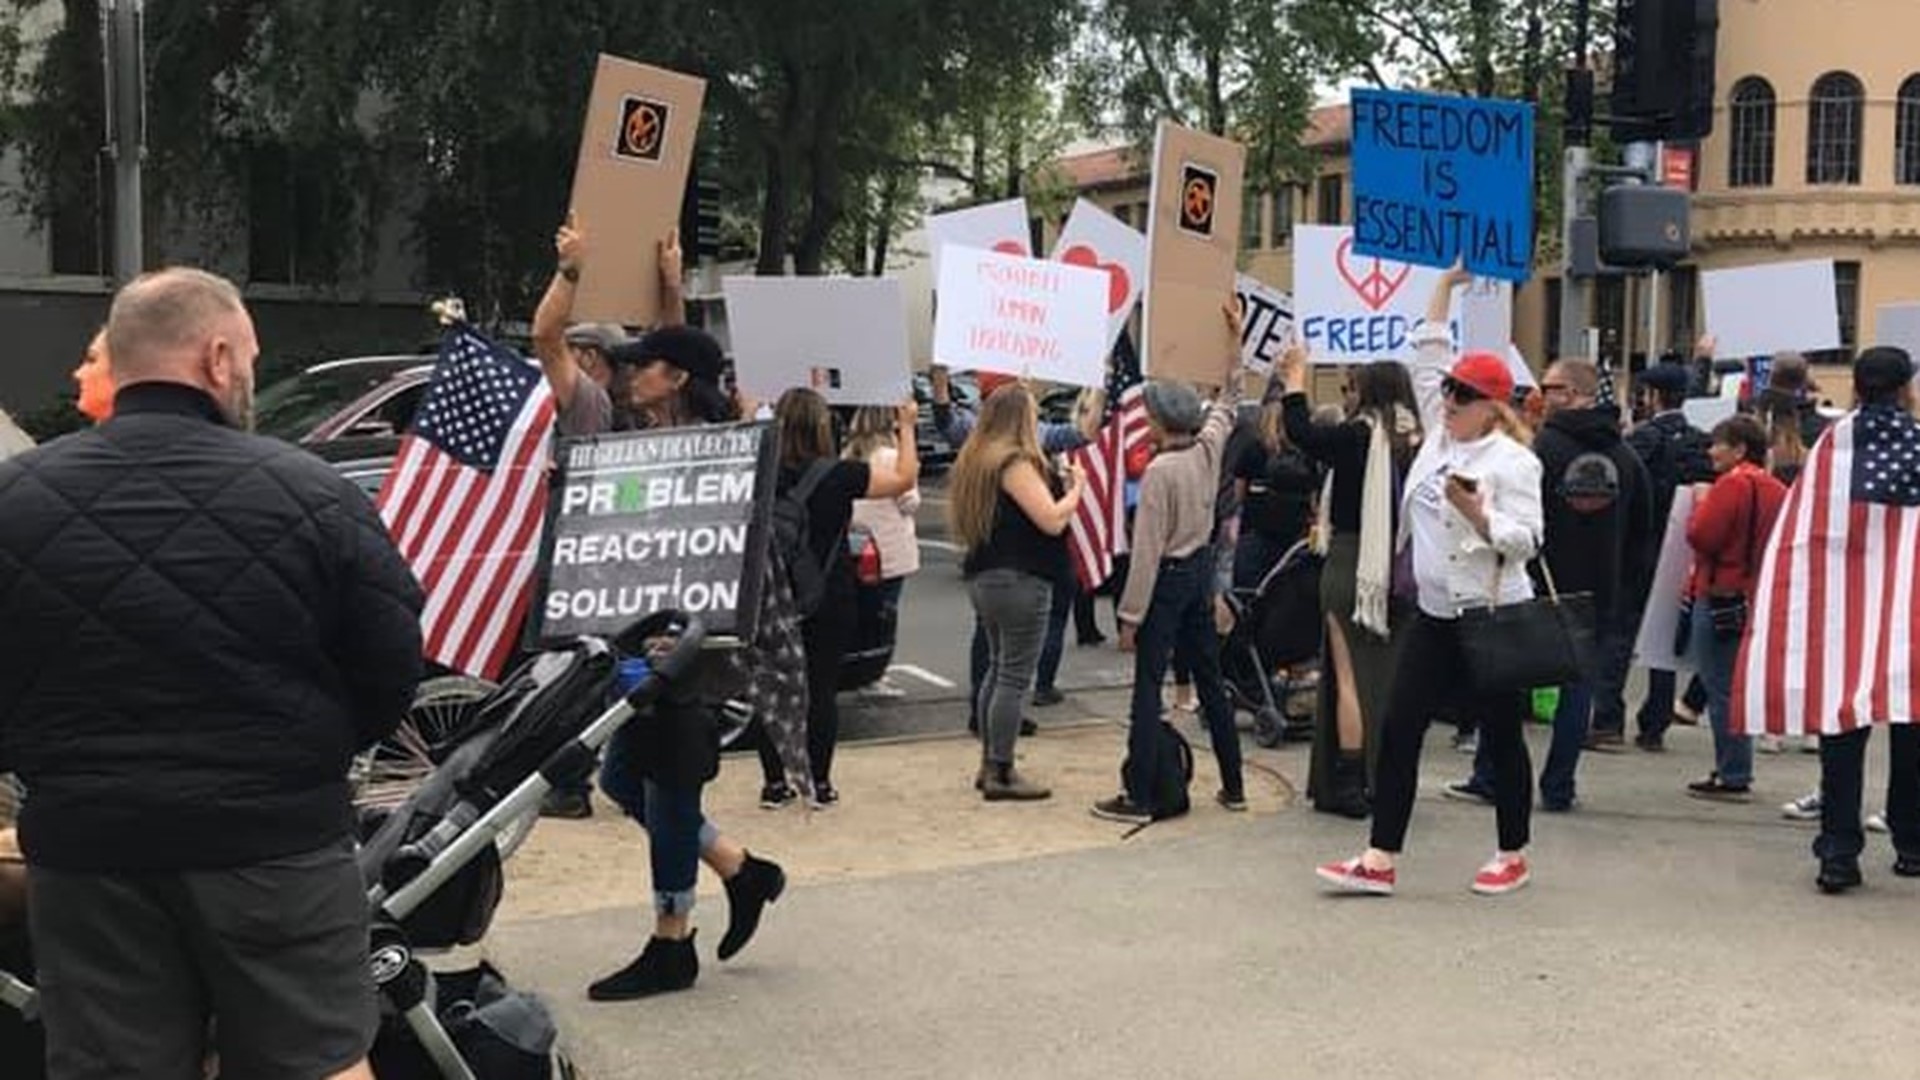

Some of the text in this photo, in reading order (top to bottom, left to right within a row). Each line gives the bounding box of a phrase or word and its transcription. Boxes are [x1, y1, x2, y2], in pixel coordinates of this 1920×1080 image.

[1352, 97, 1523, 160] FREEDOM
[1424, 158, 1458, 200] IS
[1354, 196, 1526, 269] ESSENTIAL
[1303, 316, 1459, 354] FREED
[561, 471, 755, 515] PRBLEM
[553, 524, 747, 566] REACTION
